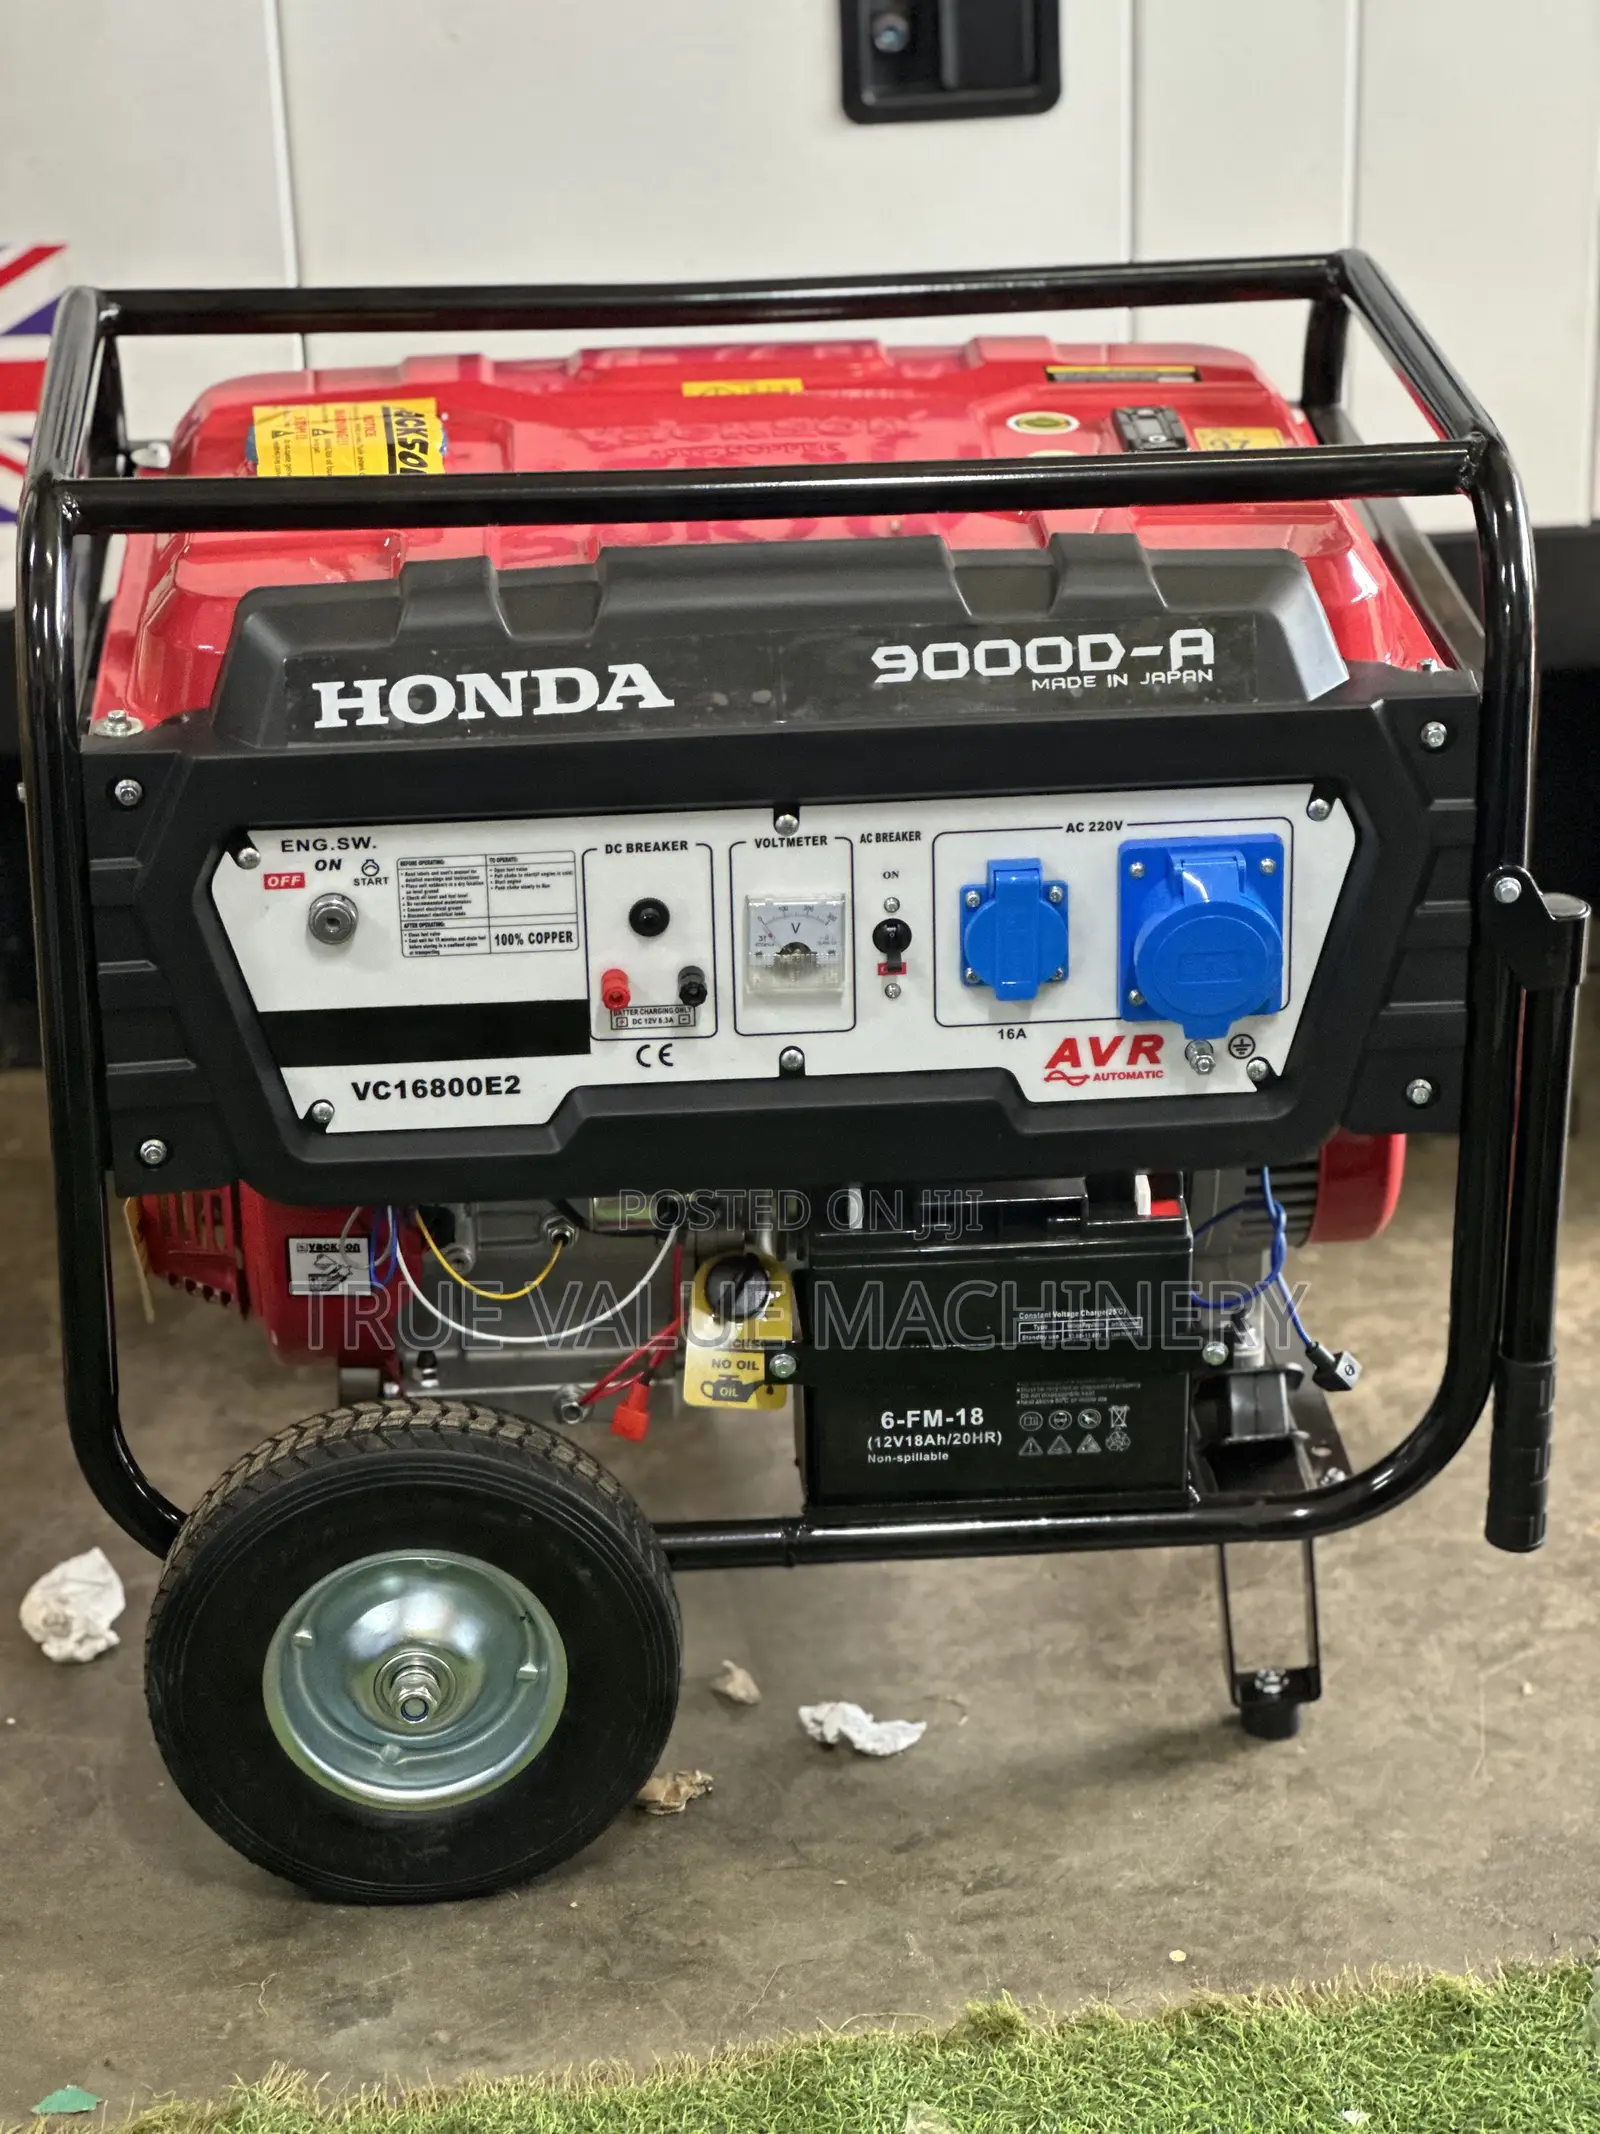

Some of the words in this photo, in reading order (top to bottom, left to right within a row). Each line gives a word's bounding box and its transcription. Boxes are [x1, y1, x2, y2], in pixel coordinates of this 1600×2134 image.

[871, 629, 1215, 684] 9000D-A
[1032, 675, 1096, 691] MADE
[1106, 672, 1128, 689] IN
[1140, 669, 1213, 686] JAPAN
[311, 662, 675, 729] HONDA
[1066, 821, 1085, 832] AC
[1089, 820, 1123, 831] 220V
[755, 835, 827, 848] VOLTMETER
[860, 832, 873, 843] AC
[875, 831, 921, 842] BREAKER
[282, 837, 376, 852] ENG.SW.
[605, 843, 623, 854] DC
[626, 841, 688, 853] BREAKER
[315, 859, 342, 871] ON
[268, 876, 301, 886] OFF
[354, 877, 389, 886] START
[883, 871, 899, 879] ON
[791, 922, 801, 934] V
[494, 933, 524, 946] 100%
[528, 931, 573, 944] COPPER
[998, 1027, 1027, 1040] 16A
[636, 1043, 673, 1067] CE
[1045, 1034, 1164, 1070] AVR
[1093, 1070, 1164, 1081] AUTOMATIC
[351, 1075, 521, 1100] VC16800E2
[1019, 1312, 1051, 1320] Constant
[712, 1358, 732, 1370] NO
[736, 1360, 760, 1370] OIL
[719, 1387, 738, 1397] OIL
[880, 1408, 984, 1429] 6-FM-18
[867, 1431, 1003, 1450] (12V18Ah/20HR)
[867, 1451, 949, 1464] Non-spillable
